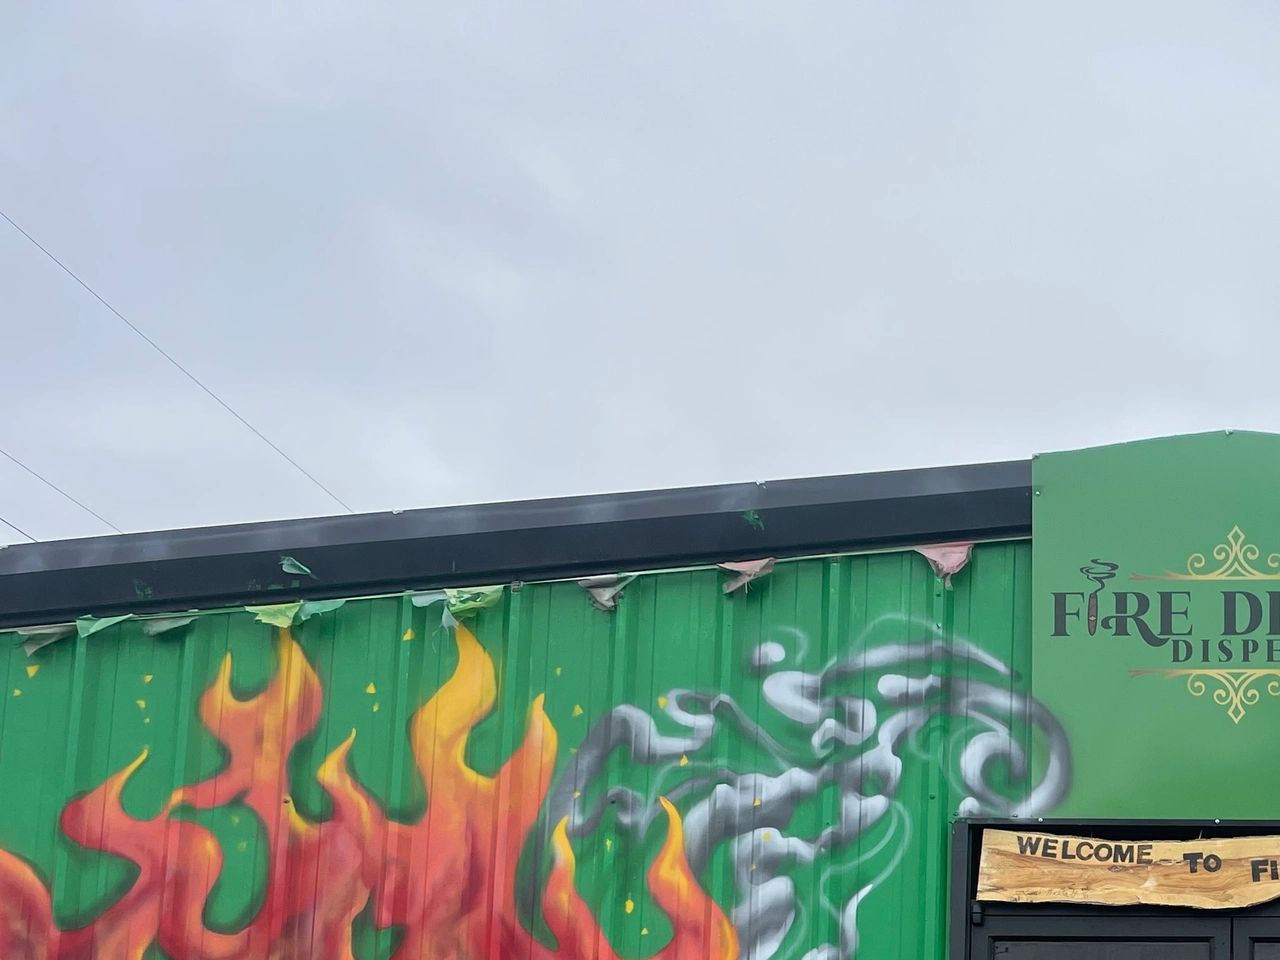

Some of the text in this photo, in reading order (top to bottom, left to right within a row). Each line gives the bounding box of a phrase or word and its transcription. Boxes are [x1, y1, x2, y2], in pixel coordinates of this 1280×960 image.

[1050, 590, 1193, 647] FIRE
[1016, 835, 1153, 865] WELCOME
[1183, 852, 1222, 874] TO
